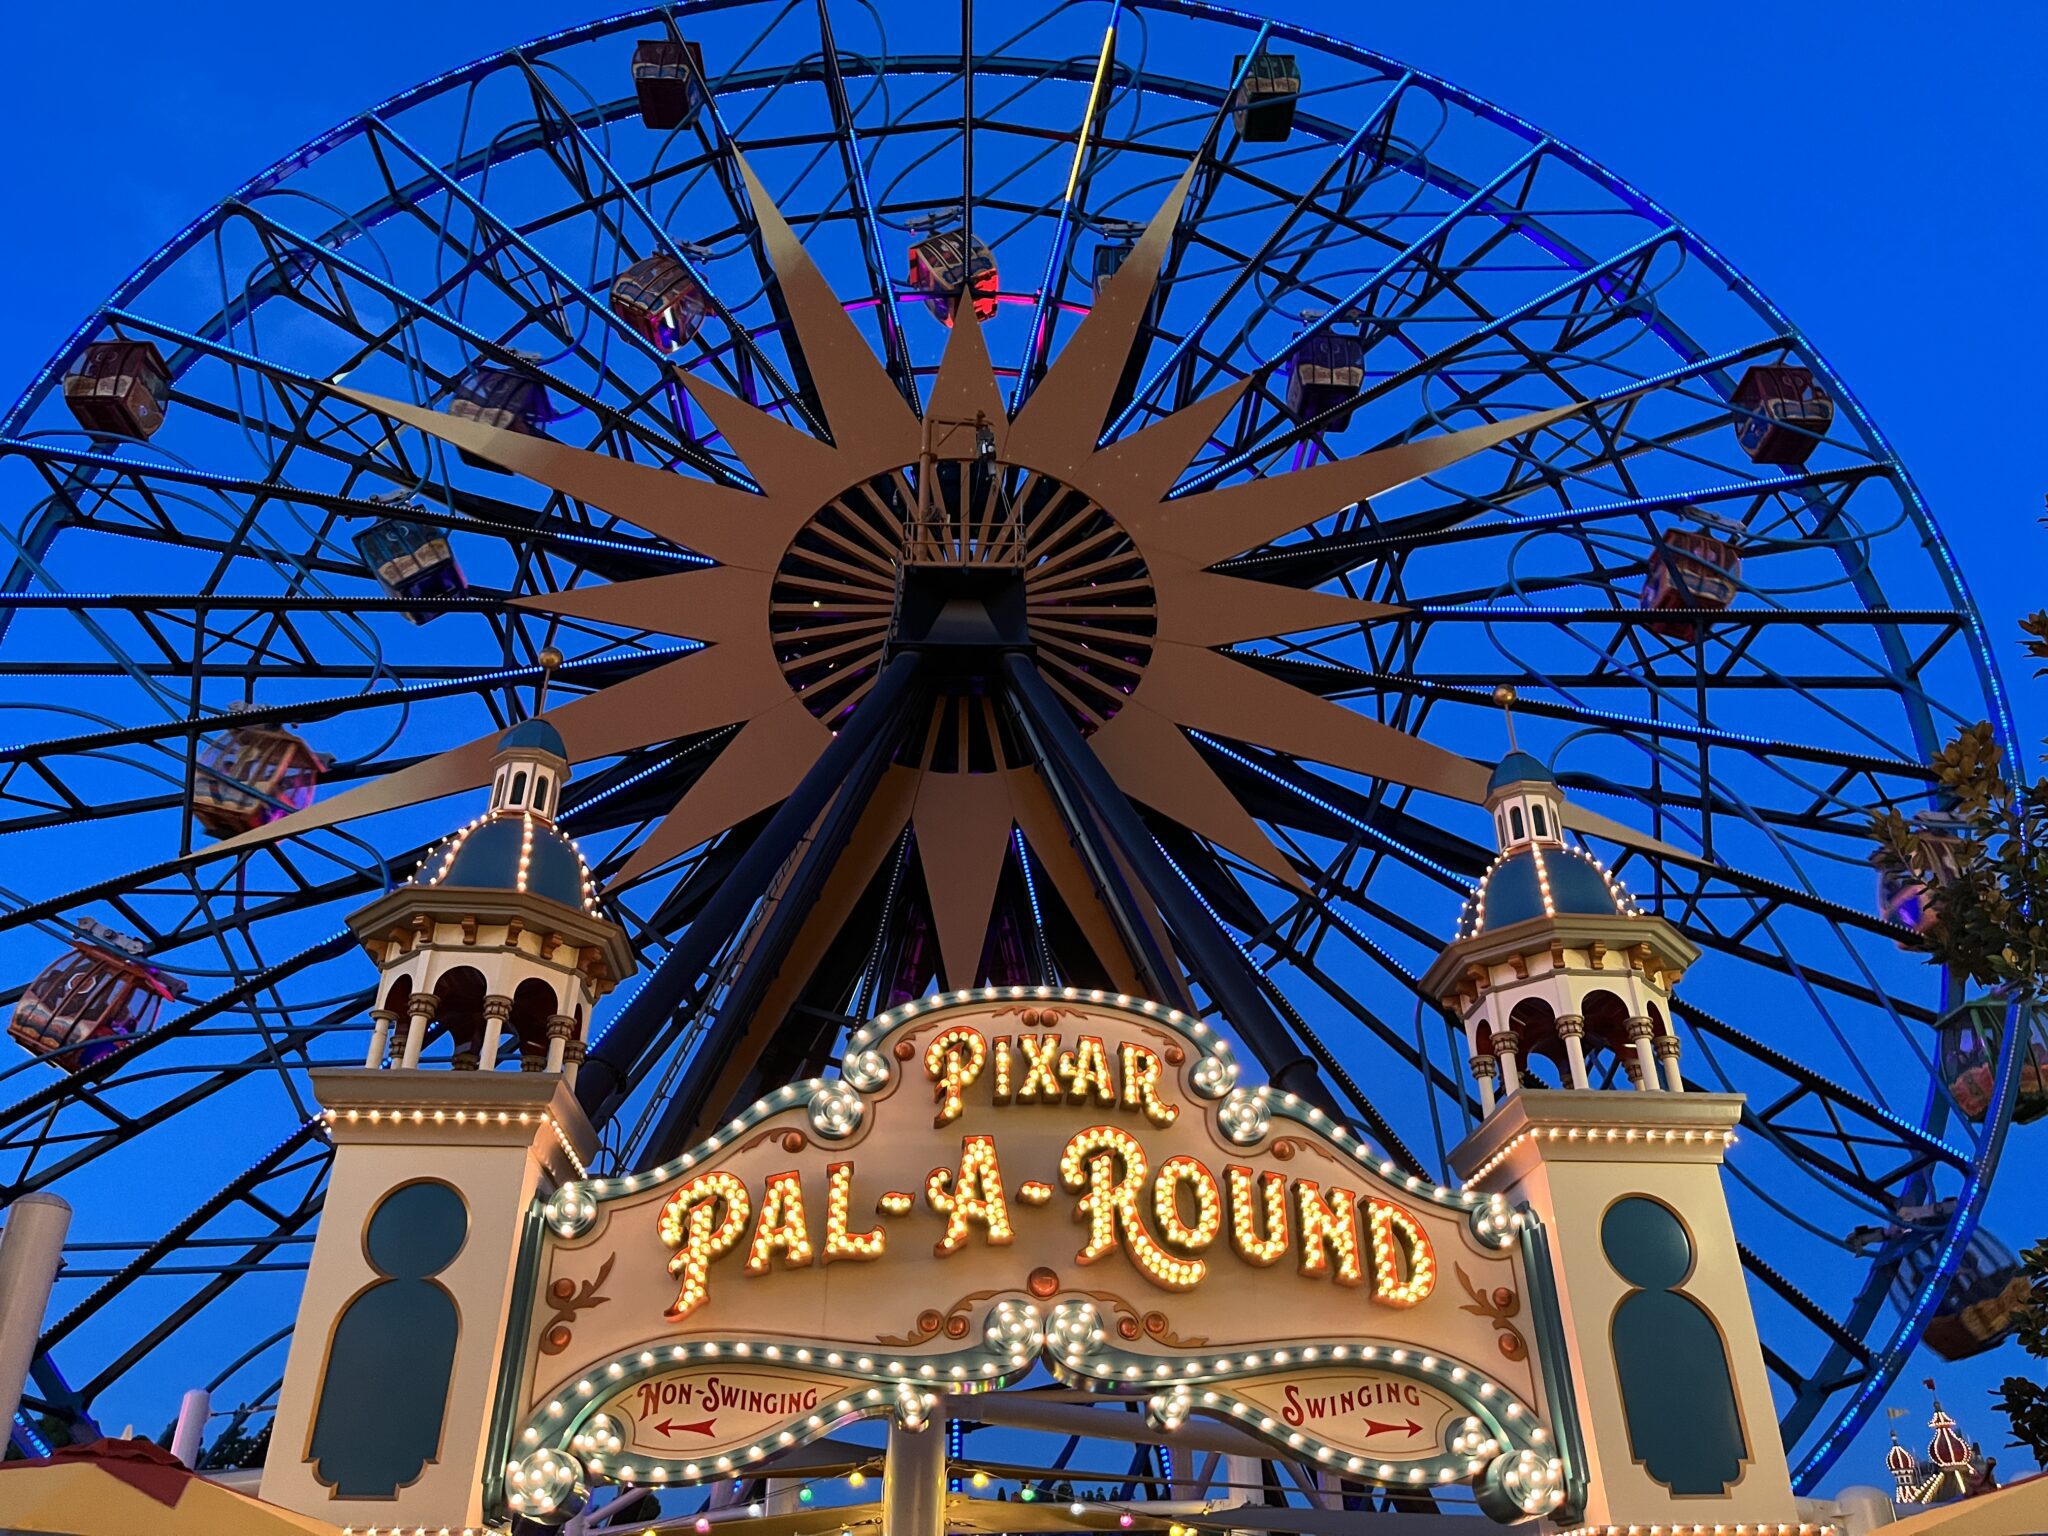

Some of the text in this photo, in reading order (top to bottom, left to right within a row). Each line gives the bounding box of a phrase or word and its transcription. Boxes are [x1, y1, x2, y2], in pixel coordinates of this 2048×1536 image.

[924, 1025, 1180, 1128] PIXAR
[656, 1125, 1438, 1322] PAL-A-ROUND
[637, 1377, 818, 1421] NON-SWINGING
[1282, 1382, 1421, 1427] SWINGING
